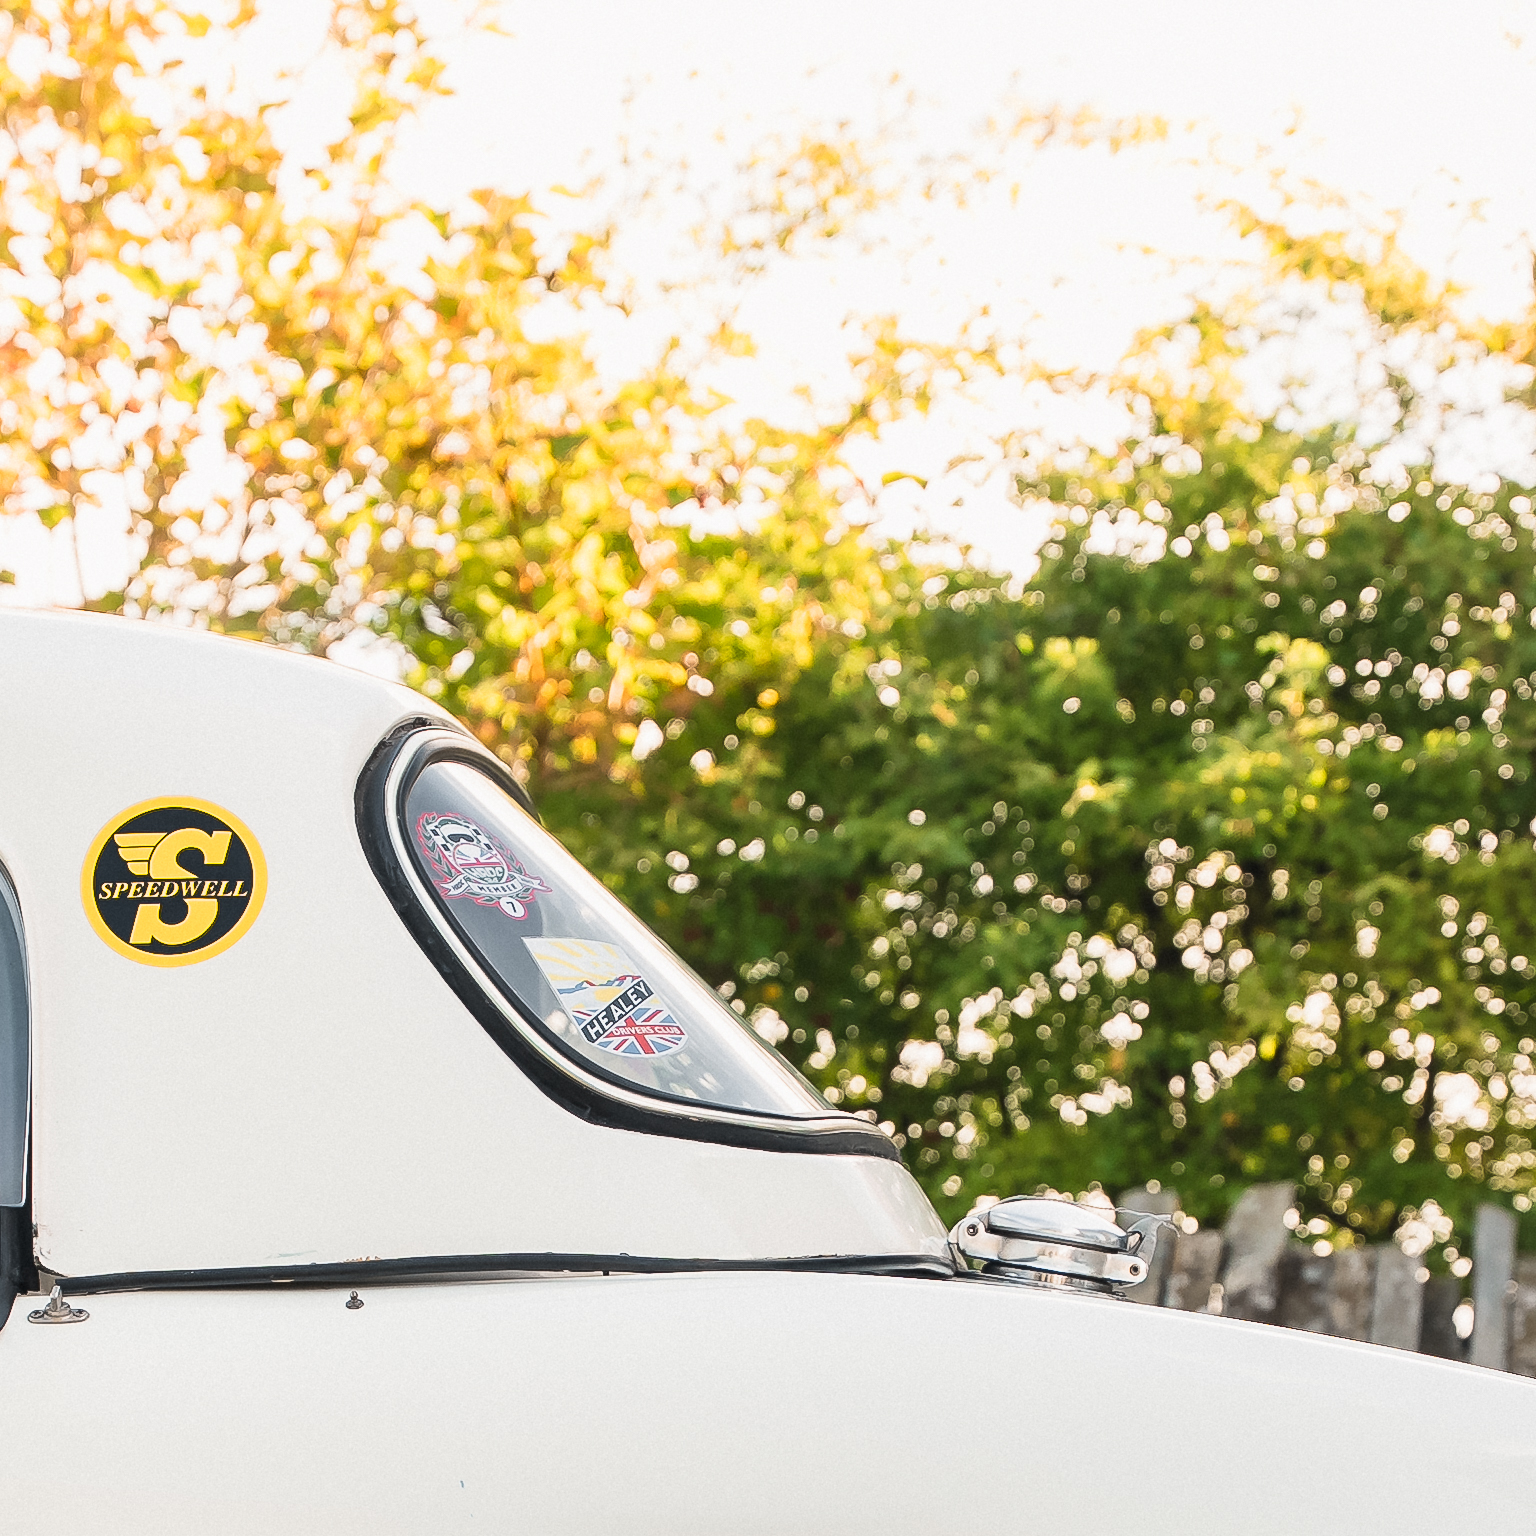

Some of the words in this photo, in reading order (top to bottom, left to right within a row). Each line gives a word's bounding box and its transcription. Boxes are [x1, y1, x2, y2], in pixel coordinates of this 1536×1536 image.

[98, 880, 249, 900] SPEEDWELL
[477, 883, 518, 893] MEMBER
[506, 901, 517, 913] 7
[586, 981, 650, 1040] HEALEY
[612, 1026, 653, 1036] DRIVERS
[654, 1026, 681, 1035] CLUB
